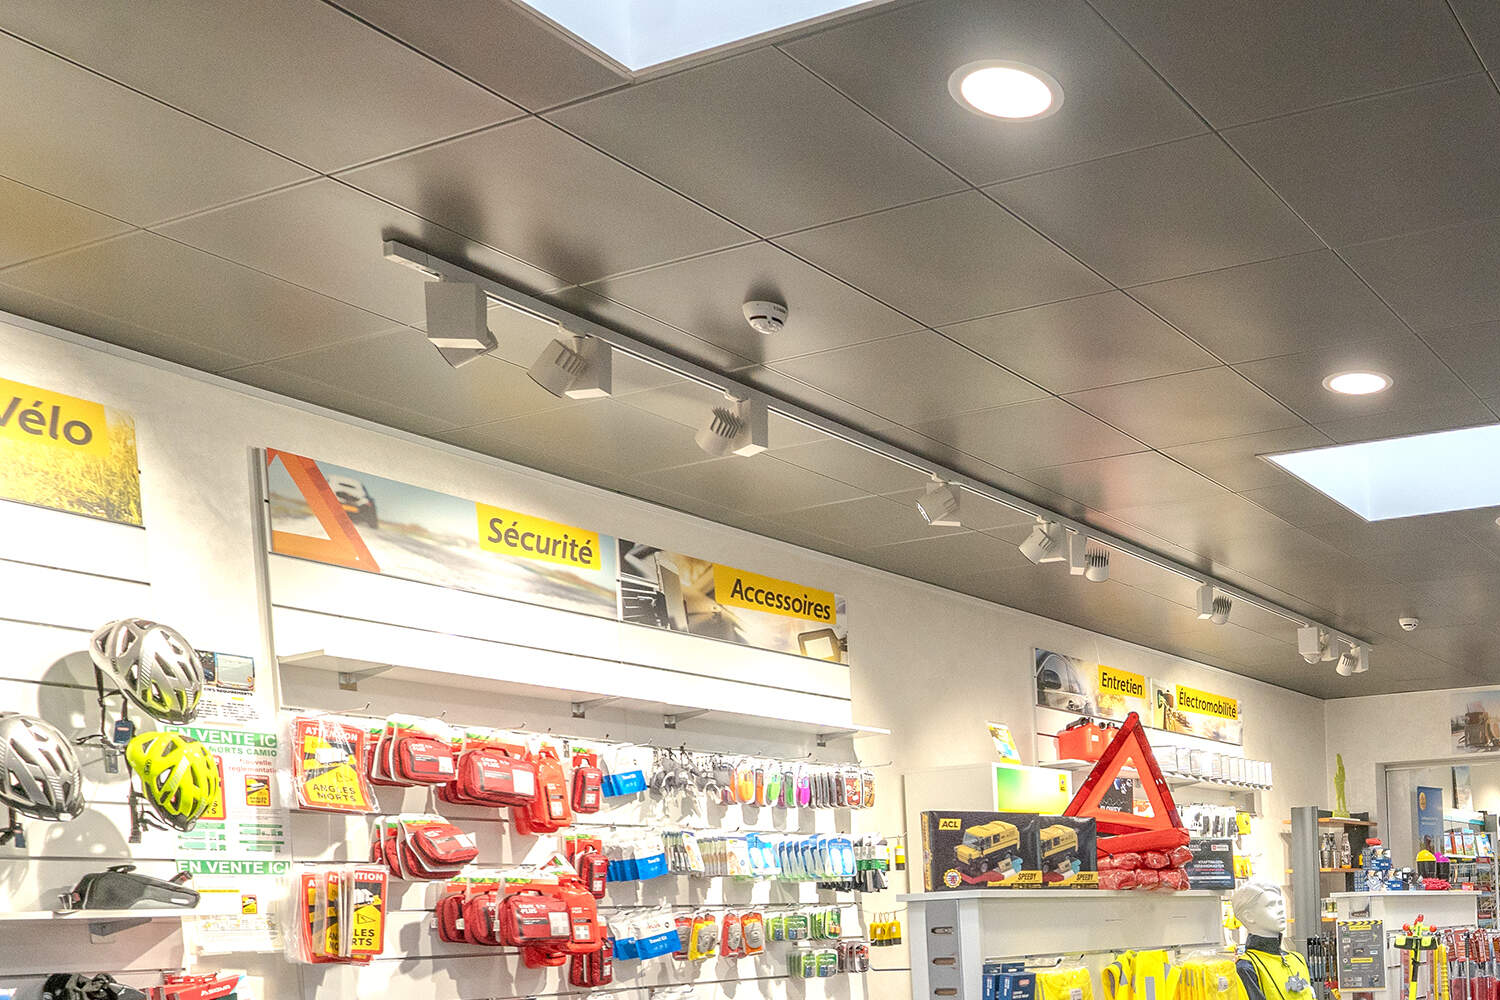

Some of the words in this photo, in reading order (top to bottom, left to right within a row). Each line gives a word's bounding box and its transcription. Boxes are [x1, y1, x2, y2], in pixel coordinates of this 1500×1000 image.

[487, 516, 594, 565] Sécurité
[730, 578, 832, 621] Accessoires
[1101, 672, 1144, 696] Entretien
[1178, 688, 1237, 719] Électromobilité
[196, 730, 256, 747] VENTE
[260, 735, 278, 748] IC
[246, 749, 278, 757] CAMIO
[941, 821, 959, 829] ACL
[177, 860, 201, 874] EN
[206, 861, 264, 875] VENTE
[267, 861, 290, 874] ICI
[1018, 872, 1037, 881] SPEEDY
[1076, 873, 1094, 881] SPEEDY
